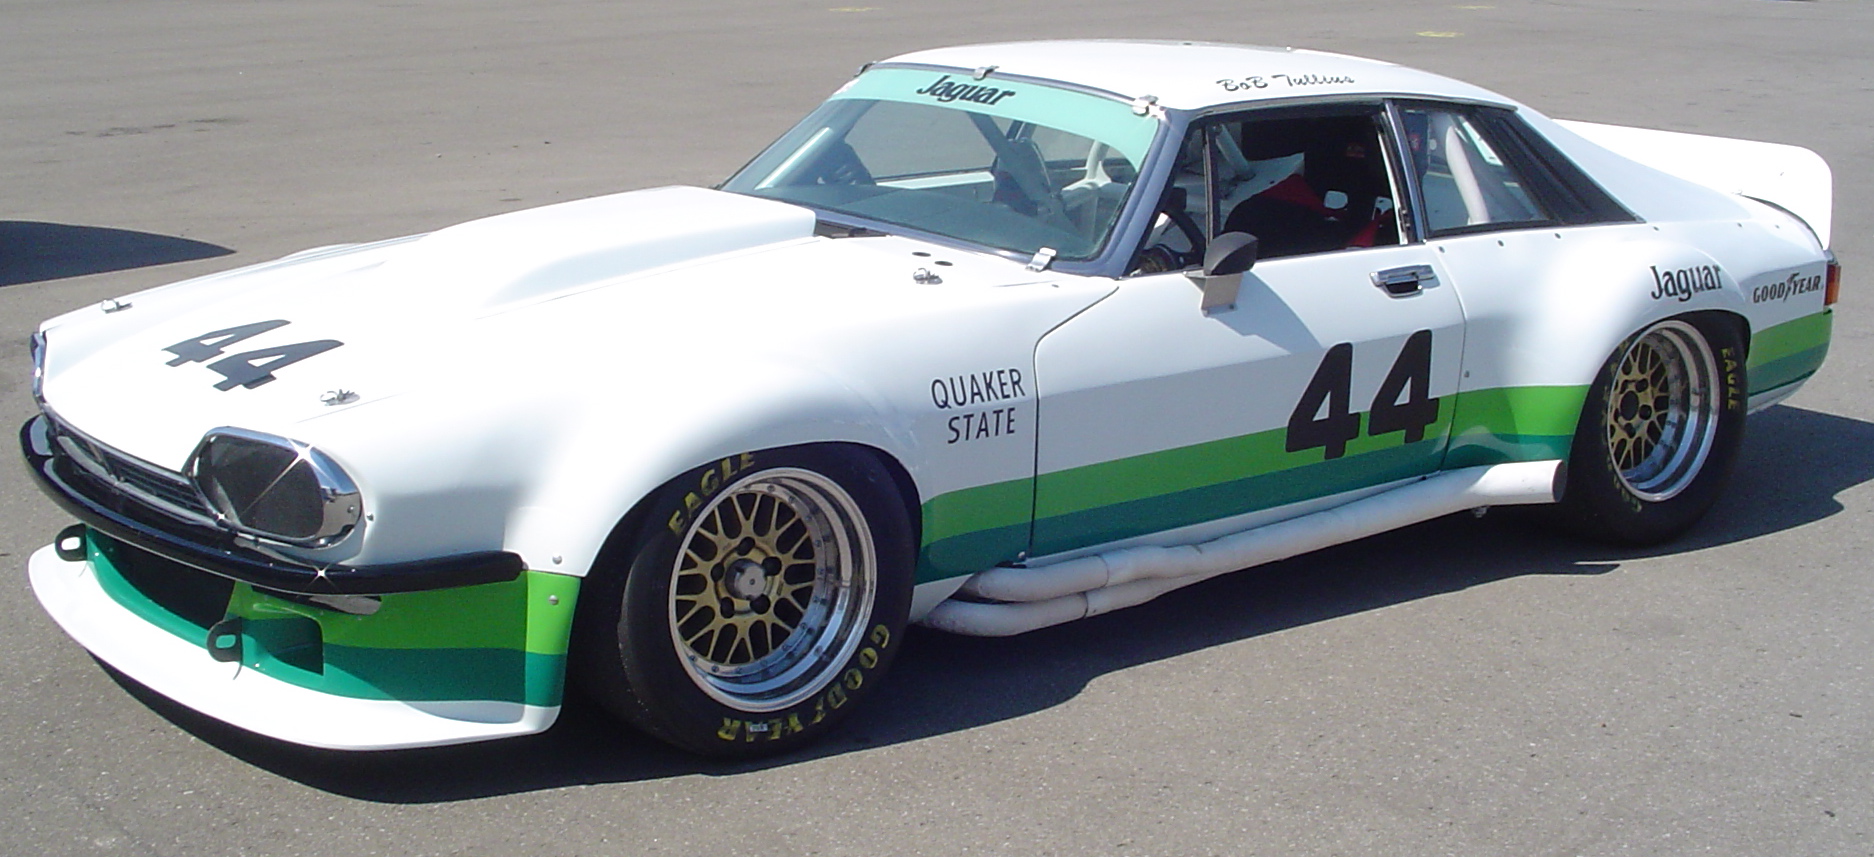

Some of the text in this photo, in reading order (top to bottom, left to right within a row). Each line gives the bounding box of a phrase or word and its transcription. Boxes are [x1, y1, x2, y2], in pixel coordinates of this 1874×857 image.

[916, 75, 1016, 105] Jaguar
[1649, 265, 1723, 302] Jaguar
[161, 319, 344, 391] 44
[1721, 347, 1740, 410] EAGLE
[931, 368, 1026, 409] QUAKER
[1285, 329, 1440, 460] 44
[947, 407, 1016, 444] STATE
[668, 452, 755, 535] EAGLE
